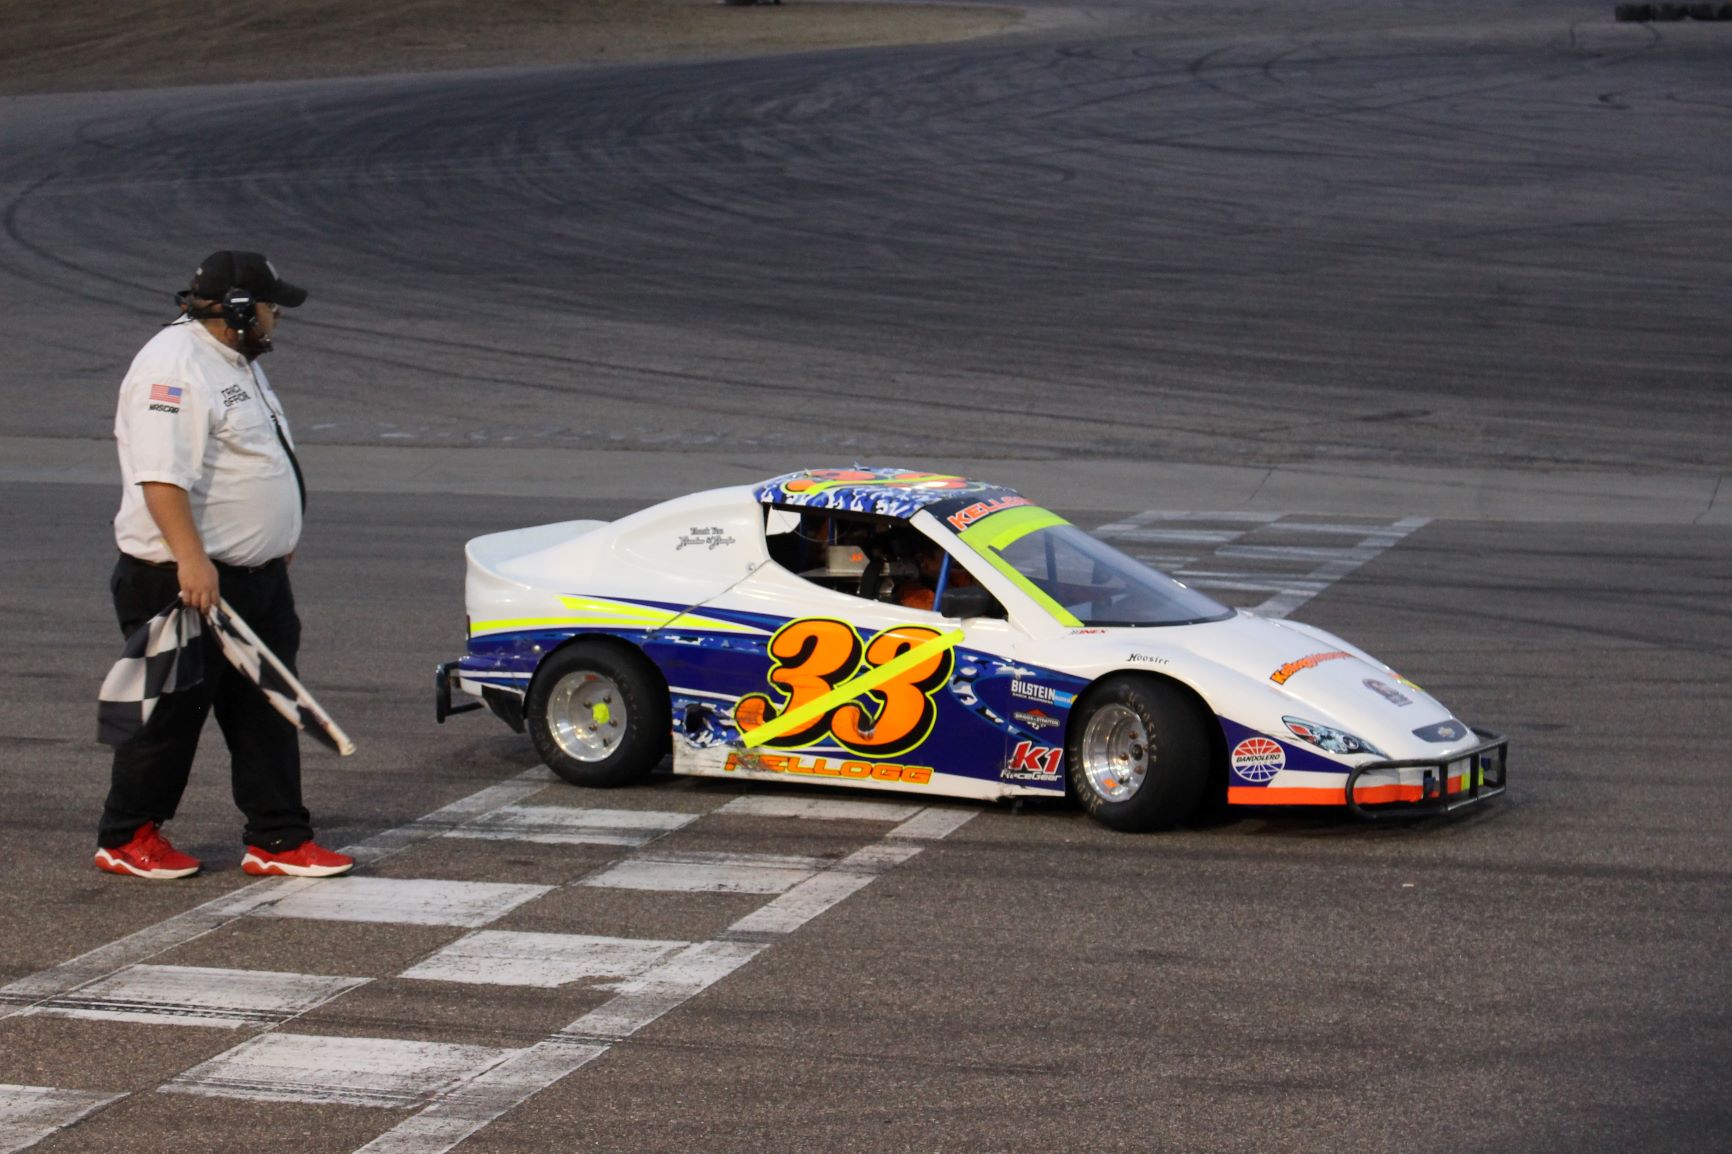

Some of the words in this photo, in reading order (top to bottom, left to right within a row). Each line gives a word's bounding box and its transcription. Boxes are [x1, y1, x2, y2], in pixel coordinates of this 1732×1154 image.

[735, 616, 956, 759] 33
[1011, 679, 1056, 701] BILSTEIN
[1008, 740, 1063, 774] K1
[1236, 754, 1281, 763] BANDOLERO
